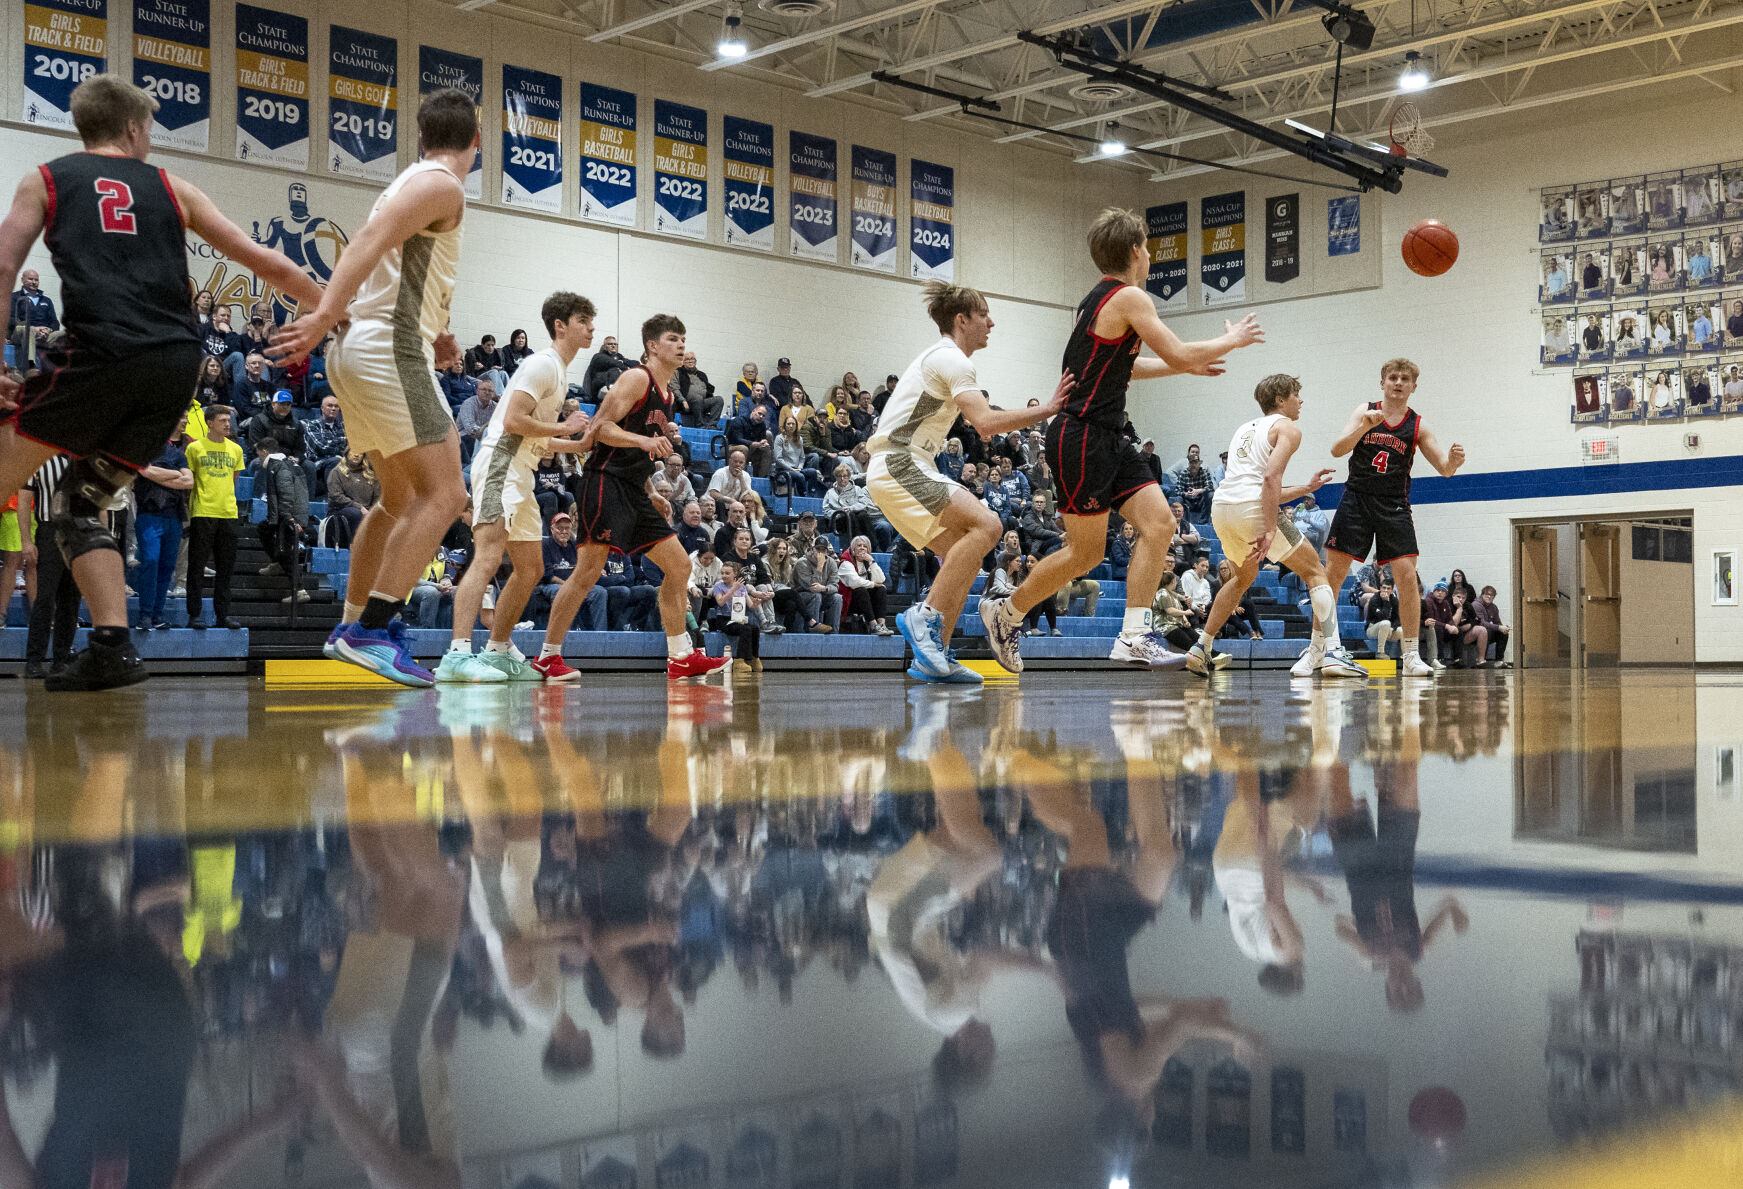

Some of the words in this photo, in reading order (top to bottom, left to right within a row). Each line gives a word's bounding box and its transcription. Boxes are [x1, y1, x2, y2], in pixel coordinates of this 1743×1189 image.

[155, 0, 188, 15] STATE
[50, 13, 81, 33] GIRLS
[138, 9, 205, 33] RUNNER-UP
[28, 25, 62, 46] TRACK
[63, 32, 73, 48] &
[74, 34, 103, 54] FIELD
[257, 23, 288, 40] STATE
[137, 38, 204, 68] VOLLEYBALL
[239, 31, 305, 56] CHAMPIONS
[350, 43, 378, 59] STATE
[33, 54, 97, 83] 2018
[259, 57, 286, 75] GIRLS
[333, 51, 395, 75] CHAMPIONS
[438, 63, 465, 78] STATE
[142, 75, 201, 105] 2018
[239, 68, 269, 88] TRACK
[270, 76, 278, 90] &
[280, 77, 305, 95] FIELD
[422, 71, 480, 94] CHAMPIONS
[520, 80, 546, 95] STATE
[335, 79, 364, 100] GIRLS
[365, 85, 390, 104] GOLF
[505, 88, 560, 110] CHAMPIONS
[244, 96, 300, 125] 2019
[596, 99, 621, 113] STATE
[333, 111, 393, 140] 2019
[507, 111, 558, 139] VOLLEYBALL
[584, 107, 634, 126] RUNNER-UP
[670, 115, 692, 129] STATE
[600, 127, 623, 145] GIRLS
[657, 123, 705, 142] RUNNER-UP
[738, 130, 760, 144] STATE
[583, 140, 634, 164] BASKETBALL
[671, 143, 694, 160] GIRLS
[725, 138, 772, 157] CHAMPIONS
[804, 145, 823, 159] STATE
[510, 146, 555, 171] 2021
[656, 155, 678, 172] TRACK
[680, 161, 686, 173] &
[687, 161, 706, 179] FIELD
[791, 153, 835, 171] CHAMPIONS
[864, 159, 884, 172] STATE
[586, 162, 631, 187] 2022
[727, 162, 770, 184] VOLLEYBALL
[854, 167, 894, 185] RUNNER-UP
[923, 172, 942, 186] STATE
[659, 176, 702, 201] 2022
[793, 176, 833, 198] VOLLEYBALL
[866, 184, 885, 199] BOYS
[913, 180, 952, 197] CHAMPIONS
[93, 176, 138, 235] 2
[728, 190, 770, 214] 2022
[854, 196, 894, 217] BASKETBALL
[913, 201, 951, 222] VOLLEYBALL
[1206, 206, 1226, 216] NSAA
[1226, 202, 1241, 213] CUP
[1276, 203, 1287, 217] G
[794, 204, 833, 226] 2023
[1169, 213, 1184, 222] CUP
[1203, 212, 1243, 225] CHAMPIONS
[855, 215, 892, 237] 2024
[1215, 226, 1233, 240] GIRLS
[913, 228, 950, 250] 2024
[1160, 236, 1176, 249] GIRLS
[1212, 239, 1230, 252] CLASS
[1230, 238, 1236, 249] C
[1155, 248, 1173, 261] CLASS
[1147, 272, 1164, 280] 2019
[1169, 268, 1186, 278] 2020
[1202, 264, 1221, 272] 2020
[1226, 259, 1243, 269] 2021
[1363, 432, 1408, 455] AUBURN
[1592, 441, 1606, 453] EXIT
[1371, 450, 1389, 474] 4
